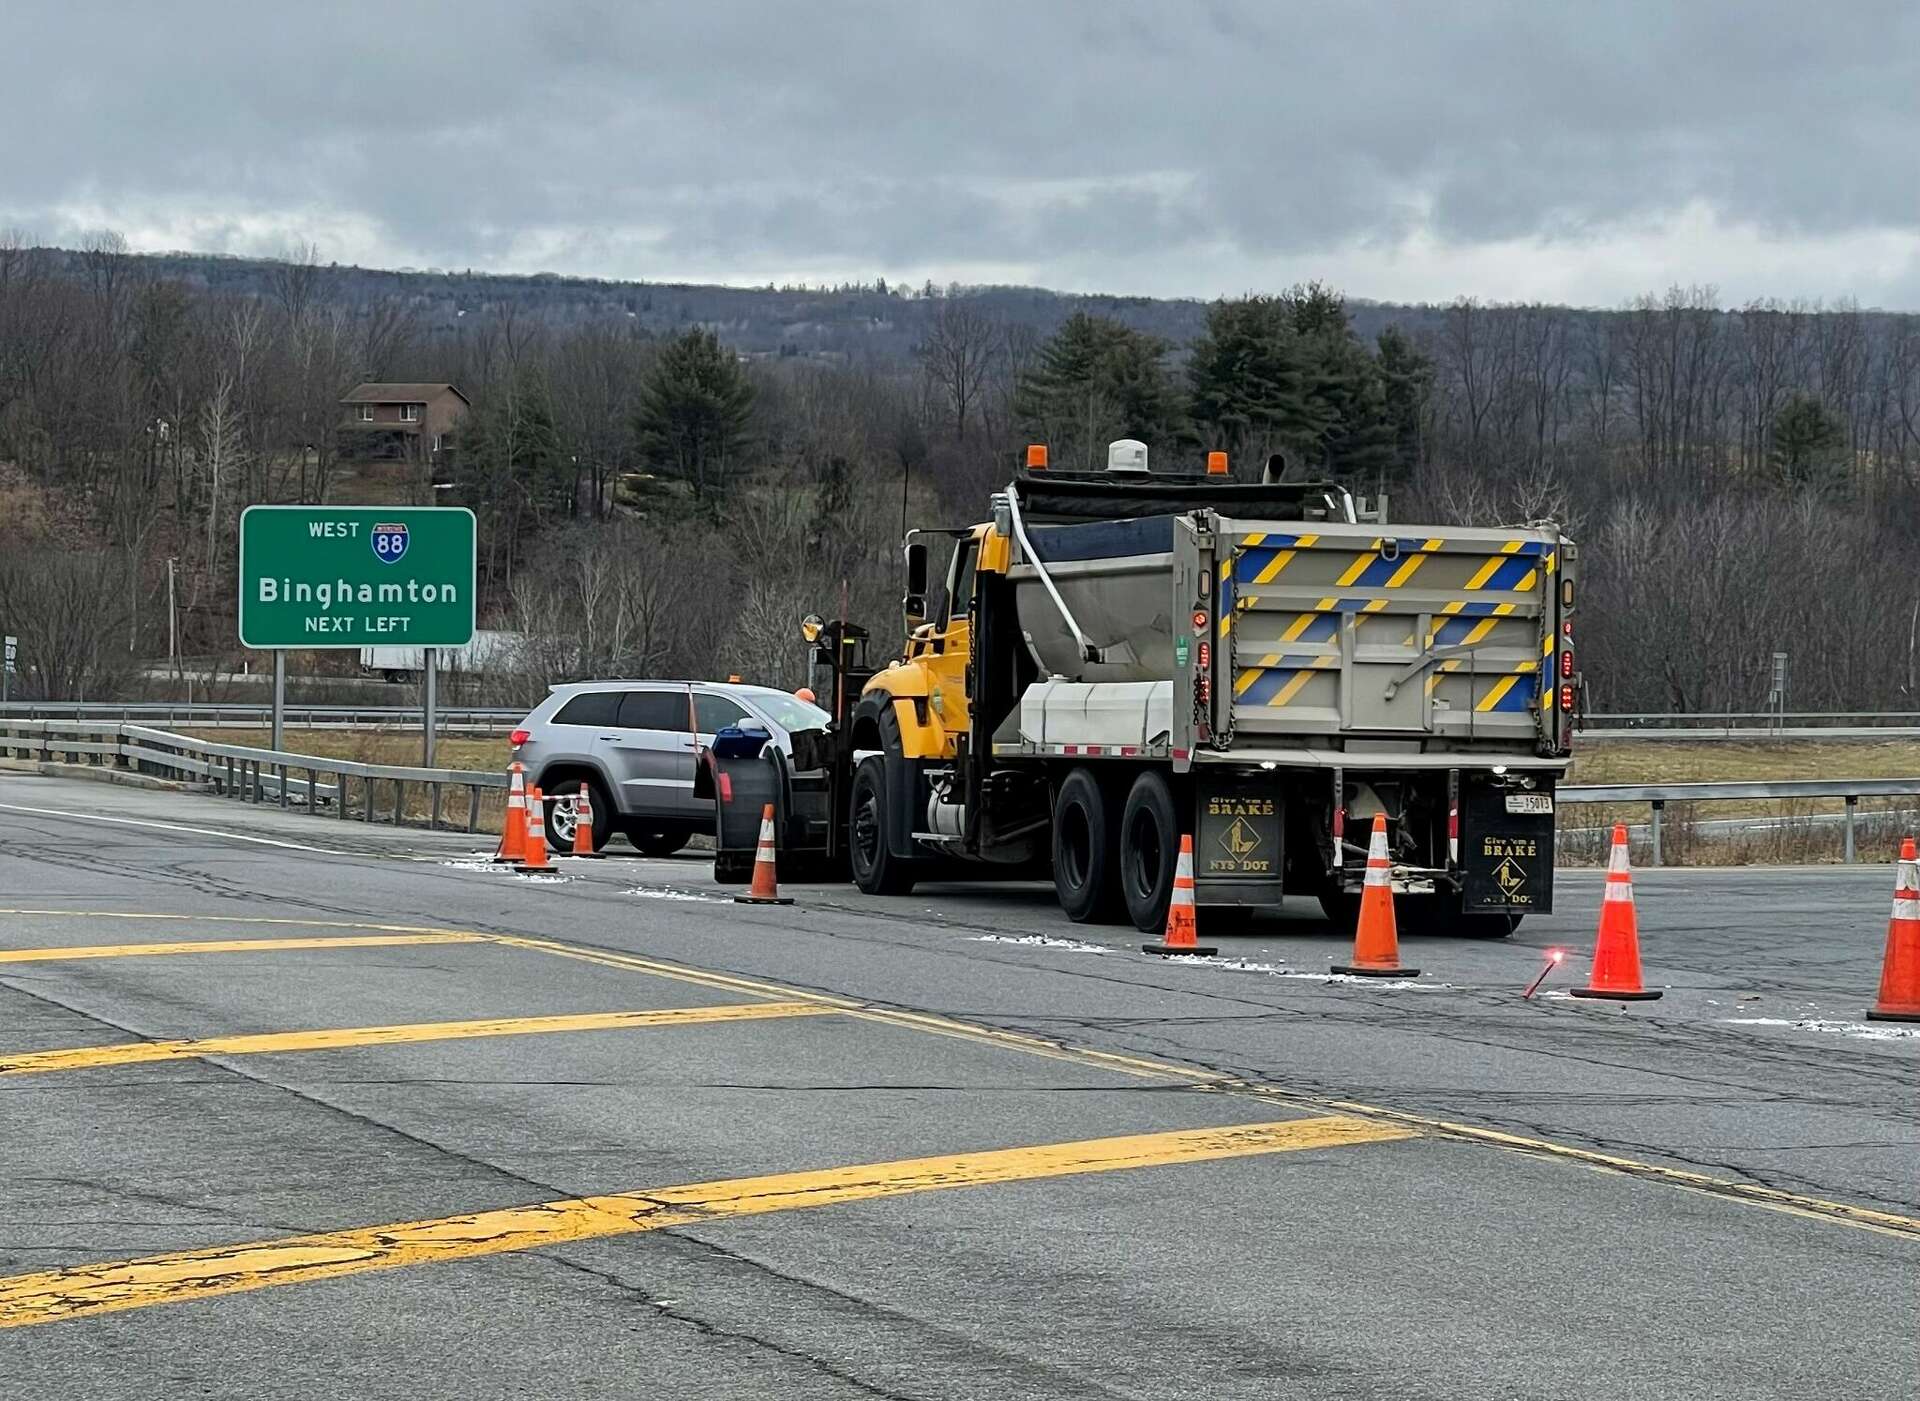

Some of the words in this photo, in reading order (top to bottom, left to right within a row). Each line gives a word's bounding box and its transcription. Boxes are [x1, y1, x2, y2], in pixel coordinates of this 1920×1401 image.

[309, 522, 359, 537] WEST
[377, 534, 403, 553] 88
[259, 577, 457, 610] Binghamton
[305, 616, 354, 632] NEXT
[365, 616, 411, 632] LEFT
[1209, 804, 1274, 815] BRAKE
[1483, 845, 1537, 856] BRAKE
[1209, 861, 1236, 870] NYS
[1242, 861, 1270, 871] DOT
